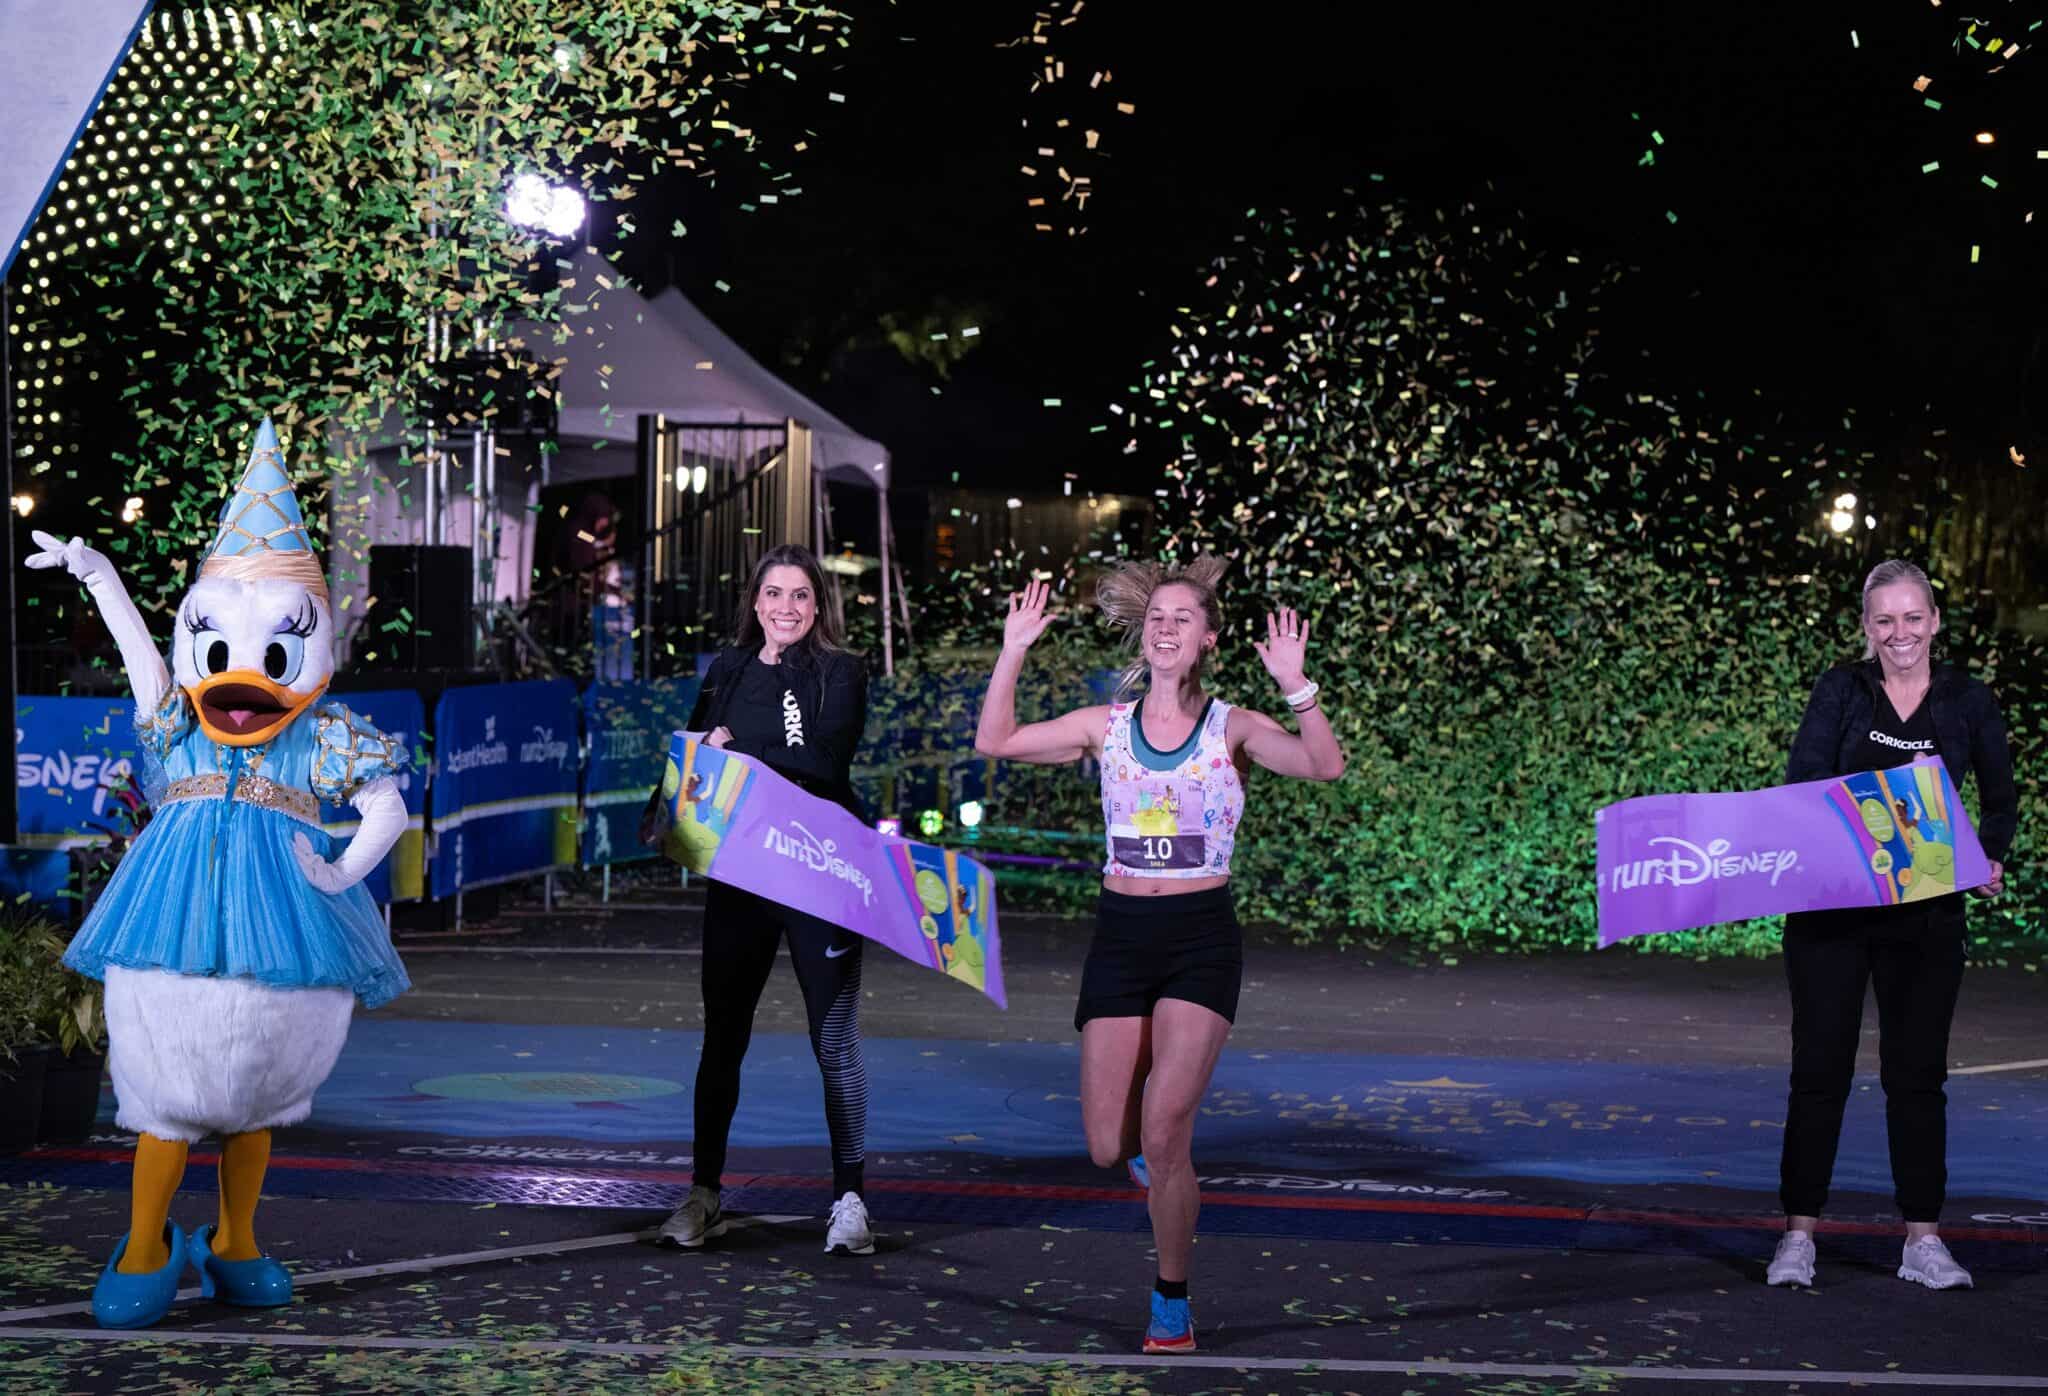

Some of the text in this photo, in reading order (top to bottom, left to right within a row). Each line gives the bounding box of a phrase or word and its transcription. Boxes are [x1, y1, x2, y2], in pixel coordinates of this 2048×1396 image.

[763, 821, 874, 907] runDisney
[1143, 837, 1172, 860] 10
[1612, 837, 1798, 893] runDisney
[1196, 1173, 1509, 1199] unDisney
